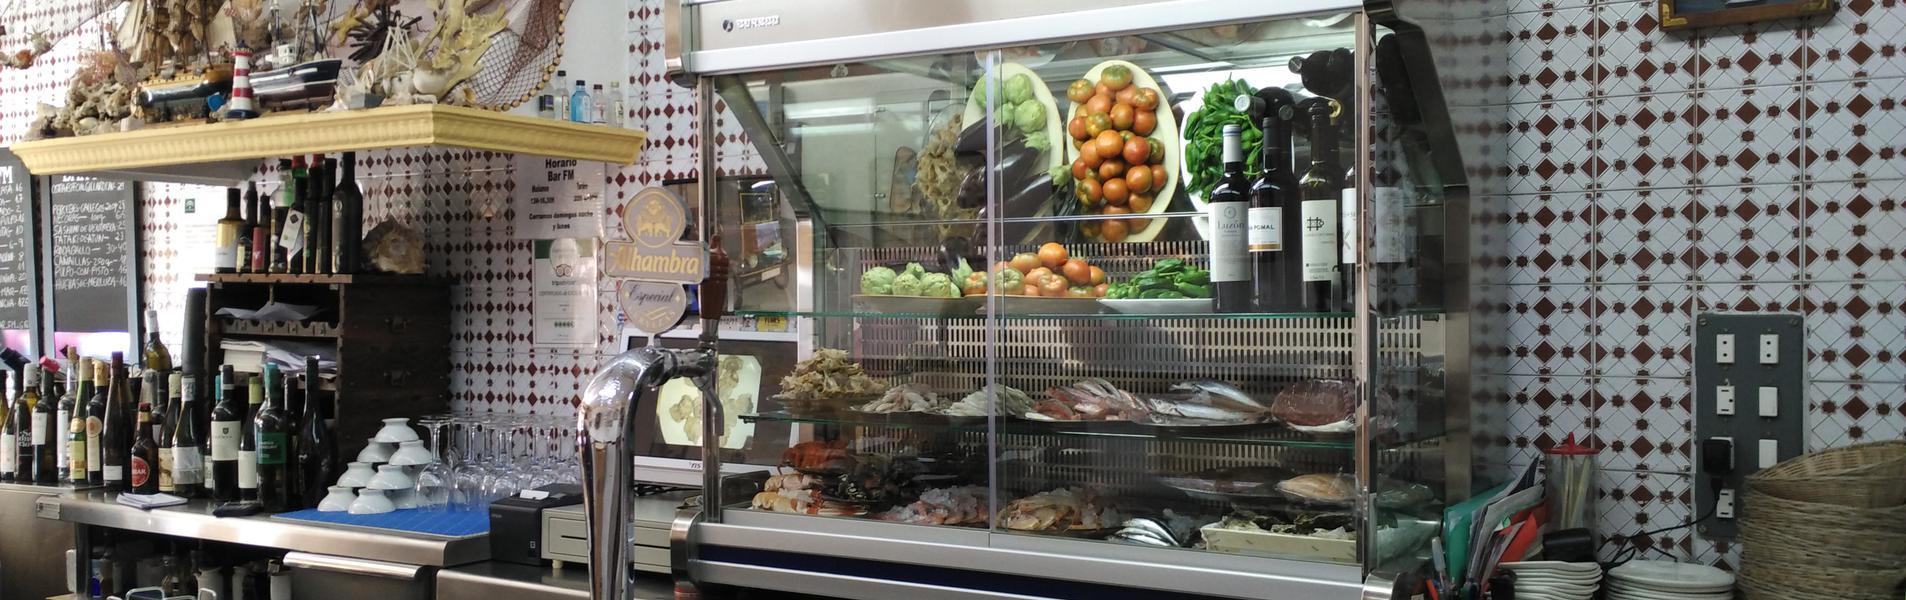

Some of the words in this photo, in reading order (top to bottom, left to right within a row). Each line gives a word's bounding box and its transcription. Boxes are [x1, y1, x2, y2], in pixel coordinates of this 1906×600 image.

[545, 158, 577, 168] Horario
[548, 171, 561, 181] Bar
[563, 169, 575, 180] FM
[1217, 220, 1245, 230] Luzón
[608, 244, 699, 275] Alhambra
[629, 284, 676, 306] Especial
